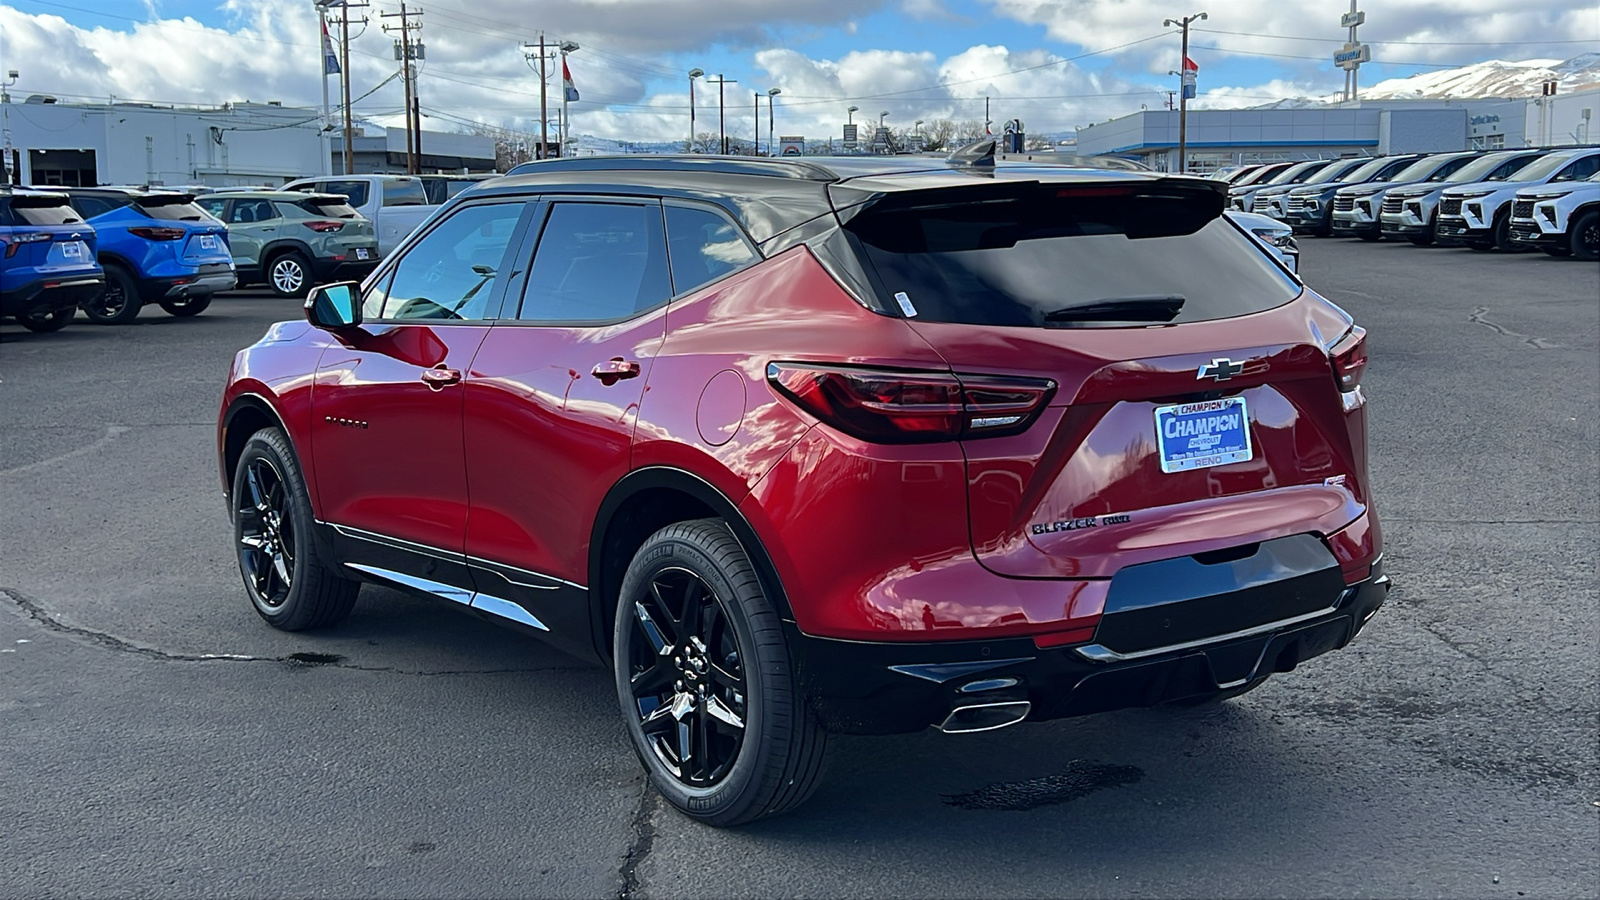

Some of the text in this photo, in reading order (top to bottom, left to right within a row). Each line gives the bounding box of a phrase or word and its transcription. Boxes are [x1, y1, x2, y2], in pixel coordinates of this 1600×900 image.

[1181, 401, 1223, 414] CHAMPION
[1164, 413, 1239, 439] CHAMPION
[1190, 436, 1219, 446] CHEVROLET
[1195, 456, 1222, 467] RENO
[1032, 517, 1097, 535] BLAZER
[633, 545, 673, 576] MICHELIN
[689, 786, 731, 810] MICHELIN
